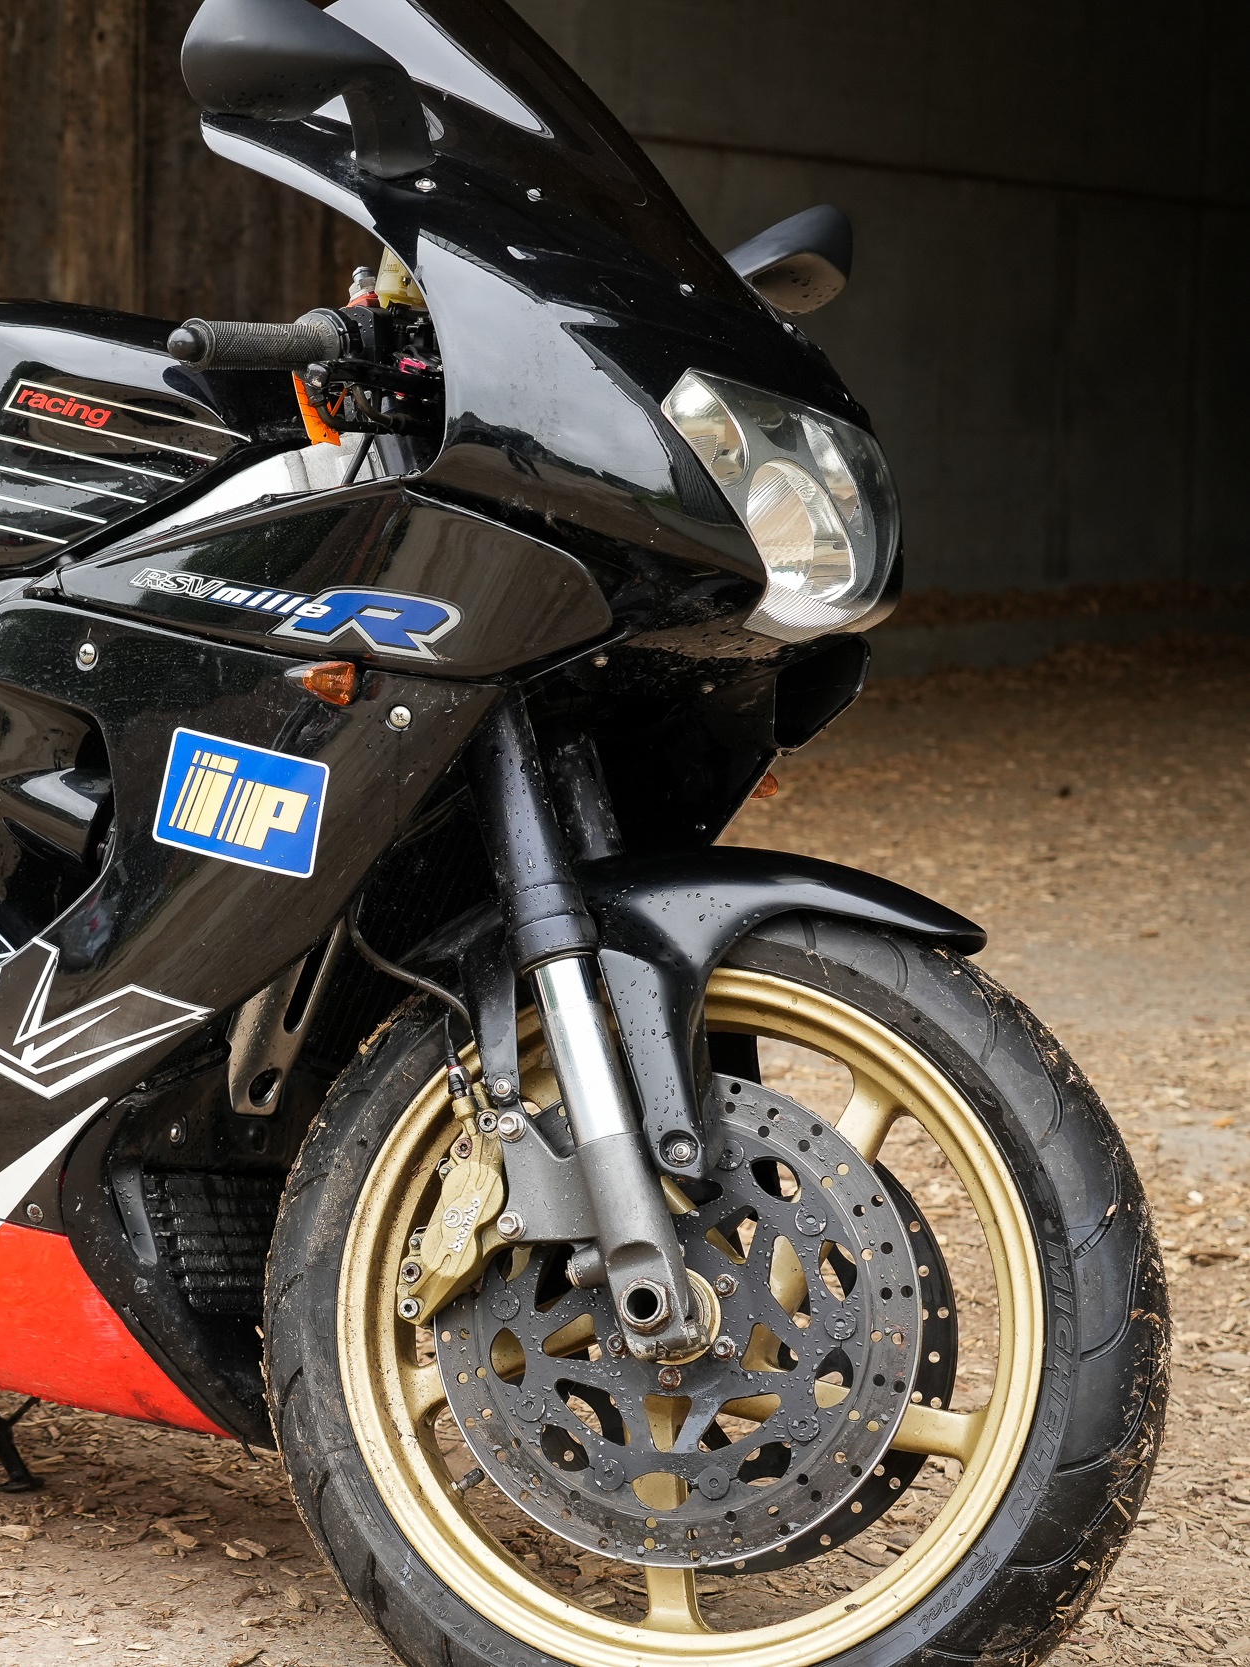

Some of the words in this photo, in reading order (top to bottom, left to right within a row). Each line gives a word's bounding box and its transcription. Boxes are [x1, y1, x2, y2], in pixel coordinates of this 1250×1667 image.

[17, 388, 112, 428] racing
[448, 1197, 481, 1253] brembo
[1007, 1239, 1074, 1530] MICHELIN
